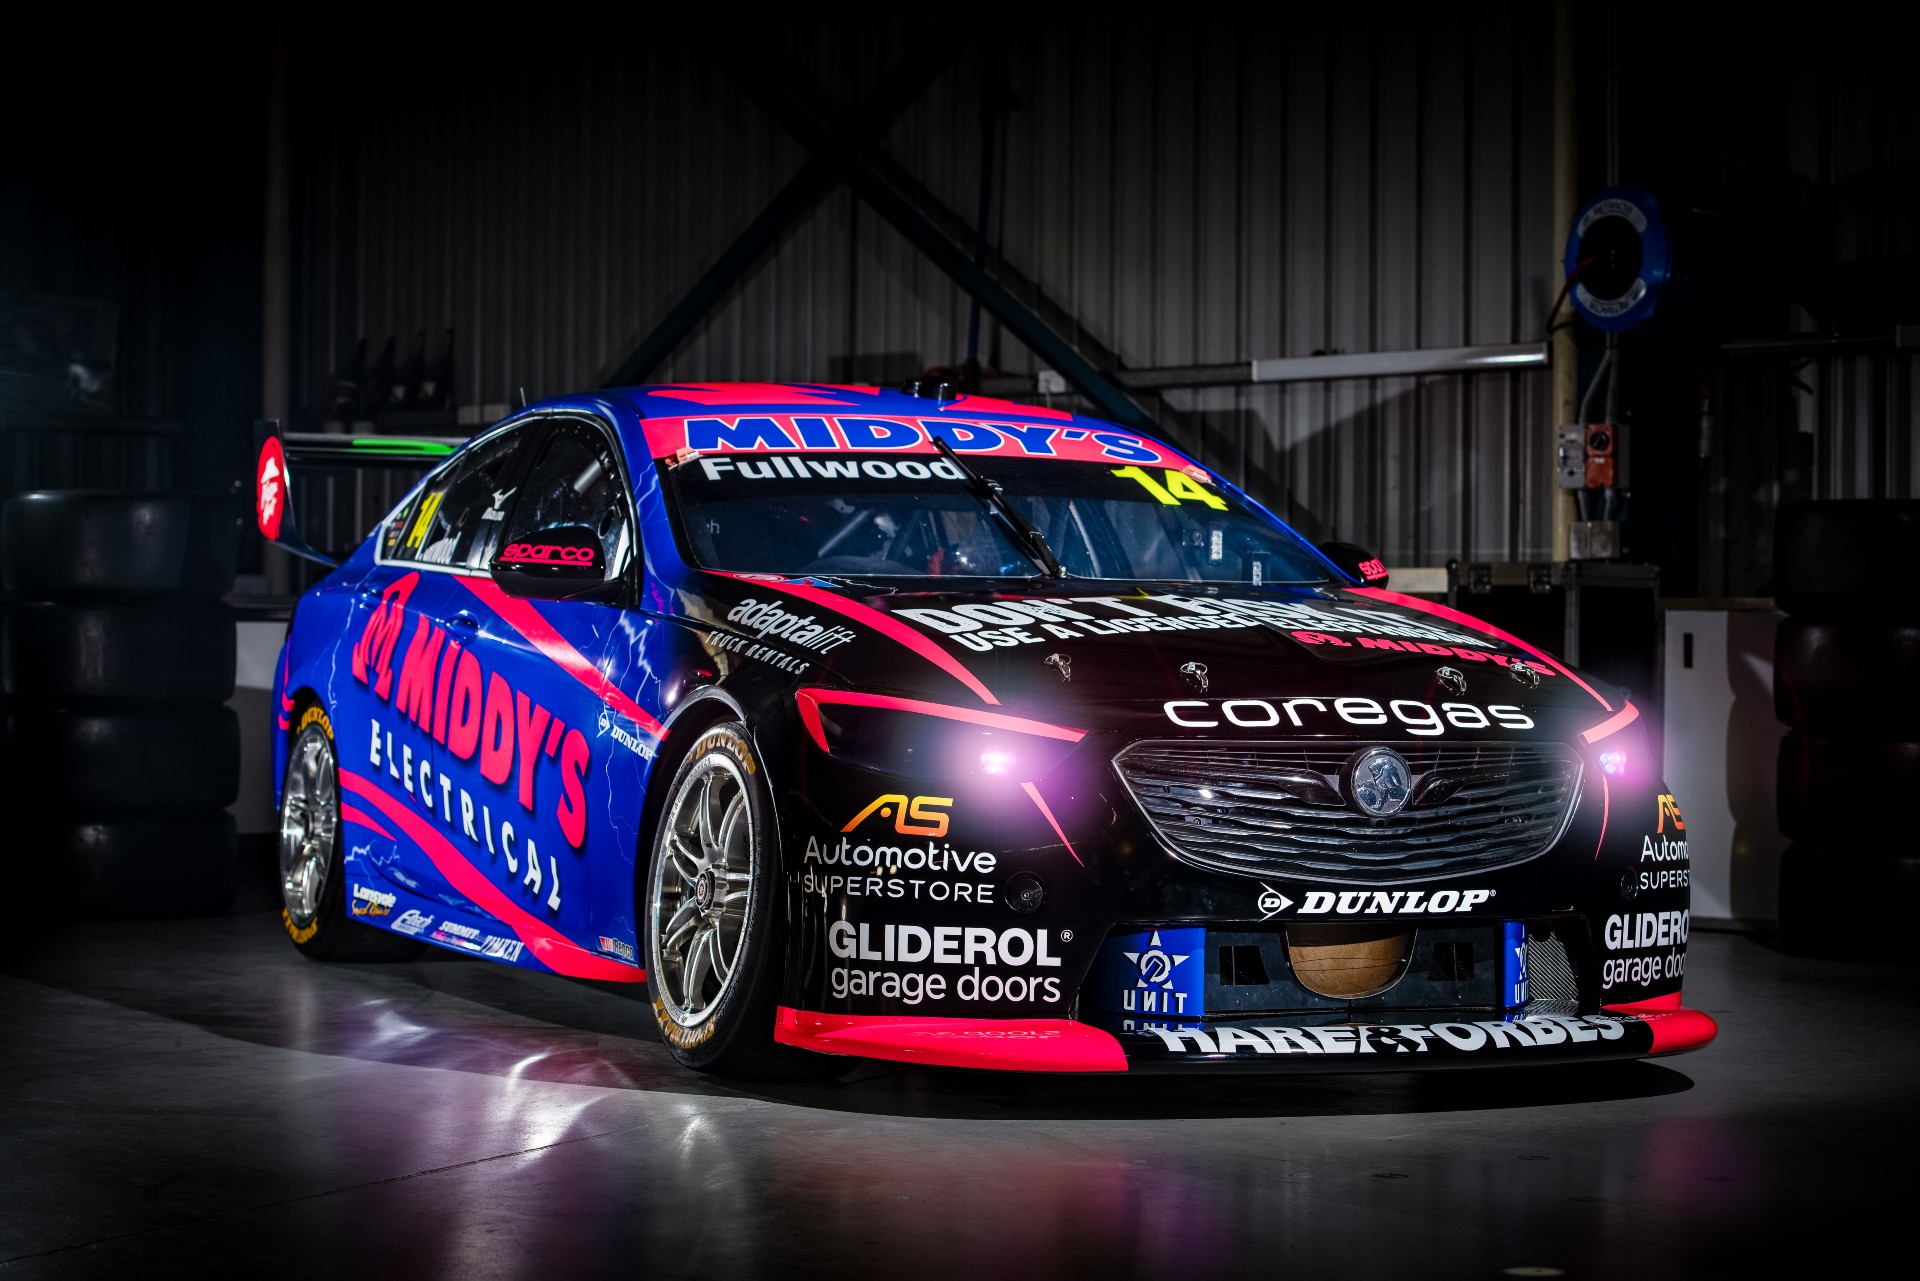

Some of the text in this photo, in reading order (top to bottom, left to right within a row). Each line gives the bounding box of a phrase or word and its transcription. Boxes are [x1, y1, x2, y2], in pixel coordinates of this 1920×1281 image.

[684, 416, 1163, 464] MIDDY'S
[701, 455, 967, 481] Fullwood
[1110, 465, 1228, 511] 14
[503, 543, 595, 563] sparco
[727, 598, 856, 655] adaptalift
[891, 596, 1158, 634] DON'T
[949, 626, 1046, 652] USE
[1040, 623, 1085, 640] A
[1072, 612, 1265, 636] LICENSED
[705, 630, 810, 675] TRUCK RENTALS
[1355, 636, 1557, 677] MIDDY'S
[395, 613, 591, 848] MIDDY'S
[1163, 698, 1535, 737] coregas
[610, 725, 654, 761] DUNLOP
[695, 731, 757, 775] DUNLOP
[369, 718, 562, 912] ELECTRICAL
[840, 793, 953, 838] AS
[803, 836, 997, 874] Automotive
[803, 874, 995, 904] SUPERSTORE
[1297, 889, 1490, 914] DUNLOP
[480, 935, 524, 963] TIMKEN
[831, 966, 1062, 1005] garage doors
[1602, 956, 1662, 990] garage
